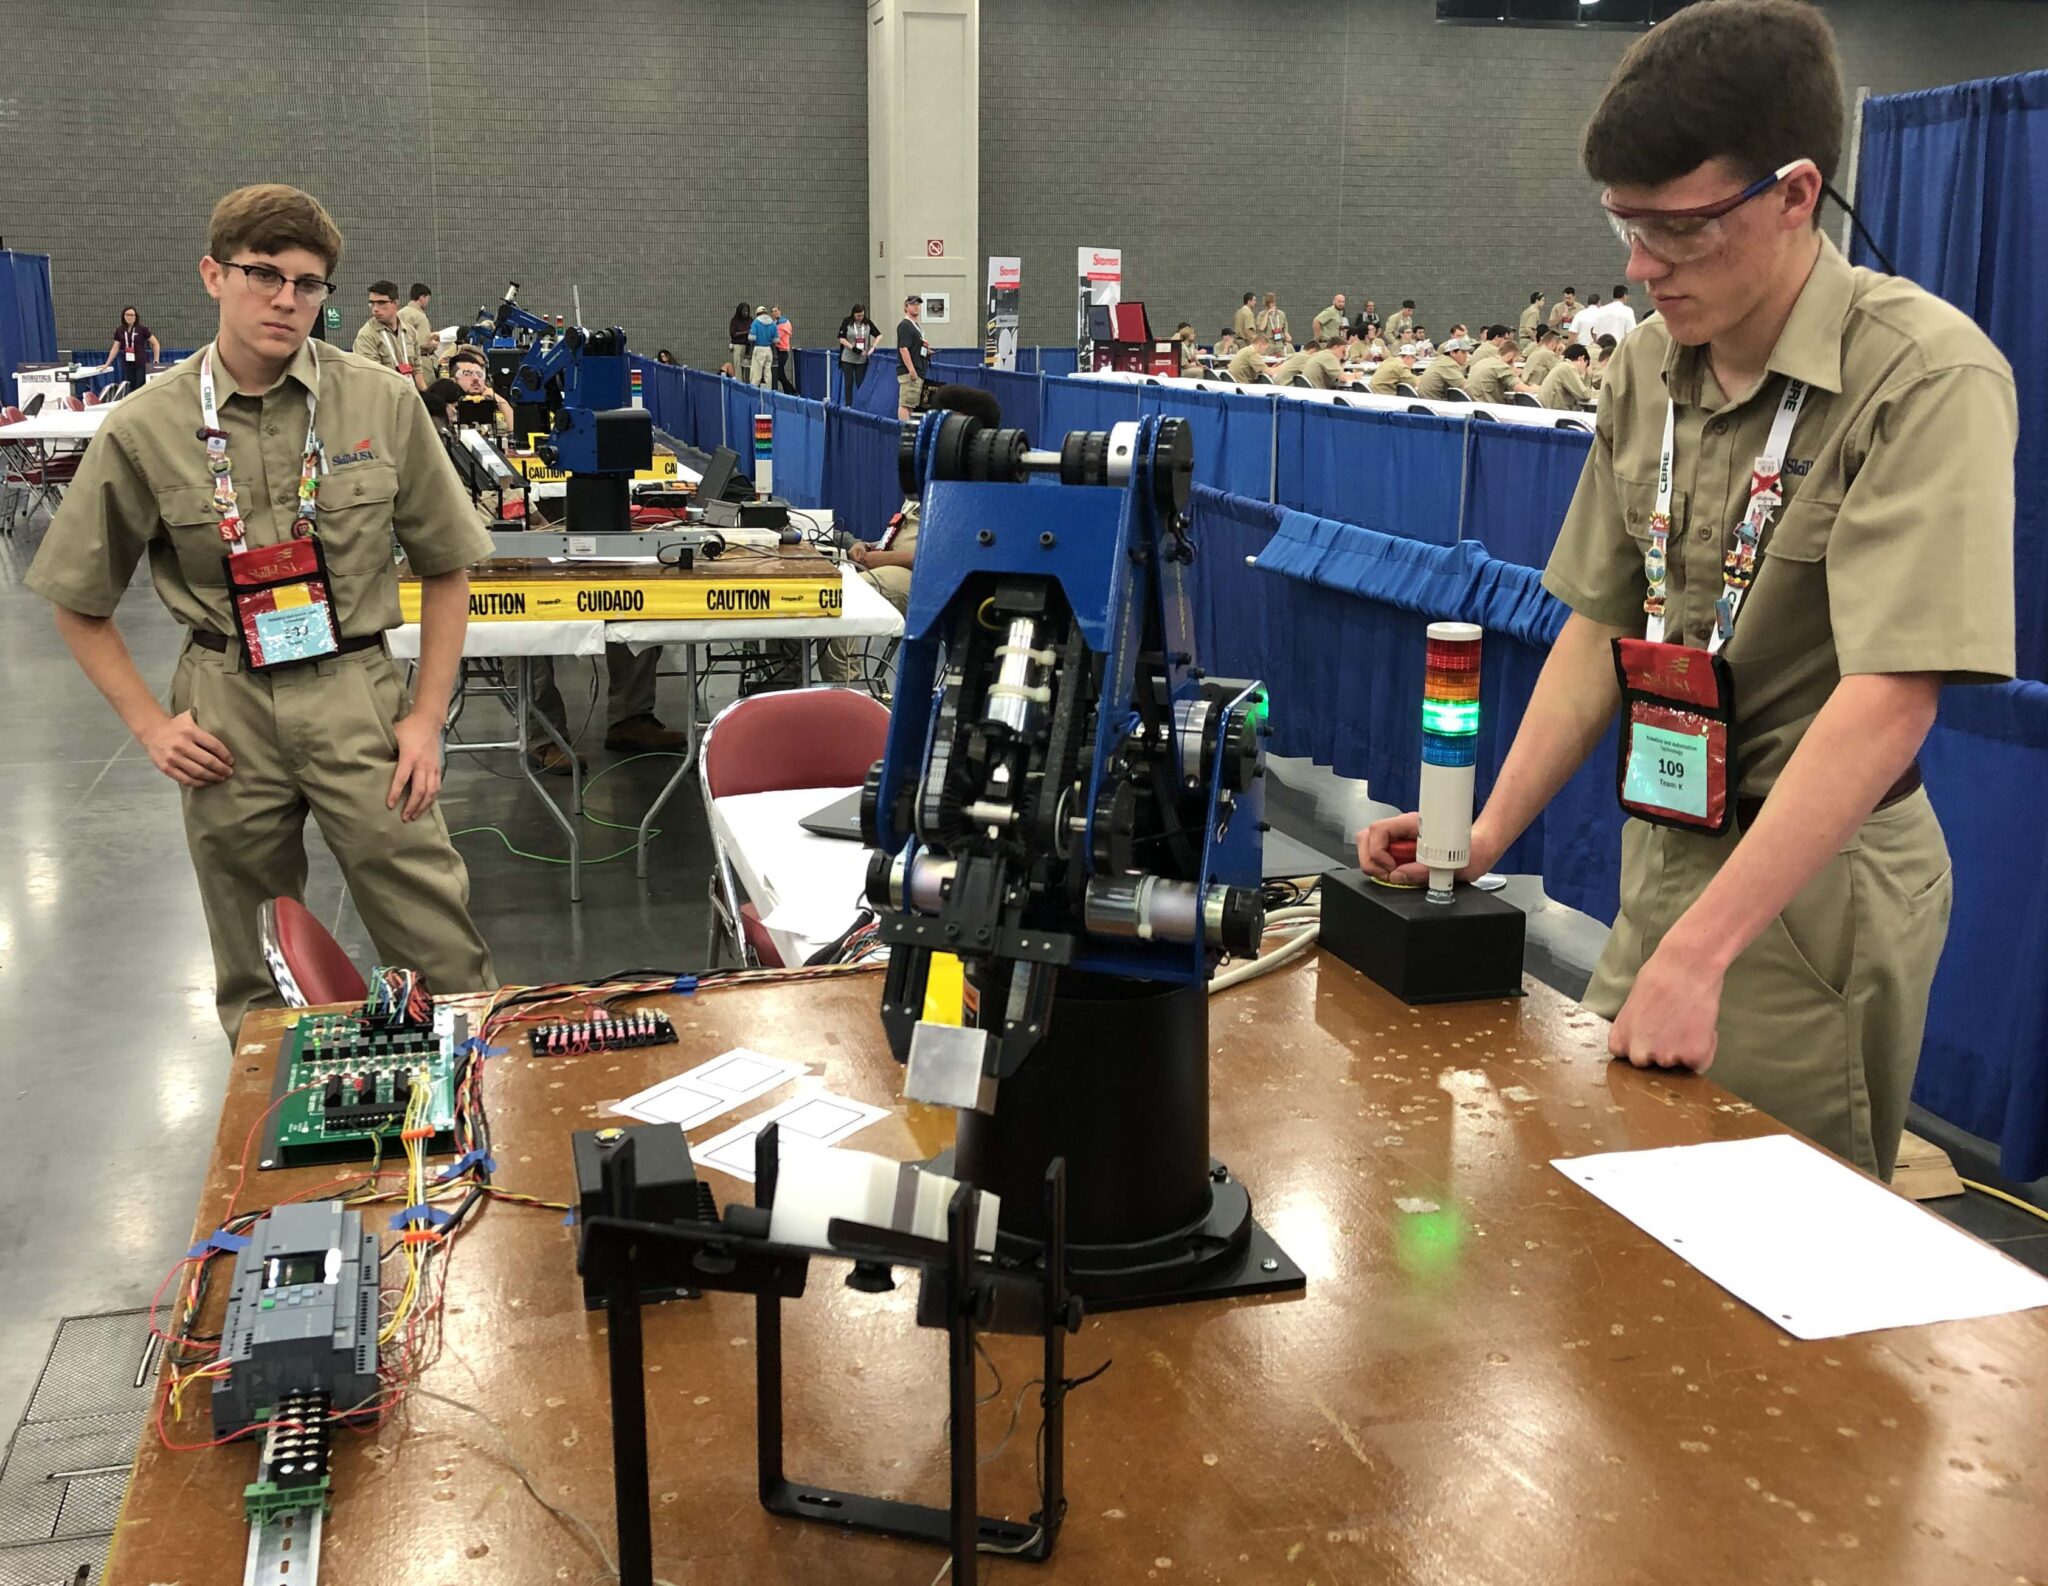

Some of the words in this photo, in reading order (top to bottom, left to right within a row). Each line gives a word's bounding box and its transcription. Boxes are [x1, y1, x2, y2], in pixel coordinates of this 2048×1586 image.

[1783, 380, 1804, 412] BRE
[1660, 451, 1670, 493] CBRE
[468, 592, 526, 616] AUTION
[577, 590, 644, 612] CUIDADO
[707, 588, 770, 611] CAUTION
[1658, 758, 1685, 779] 109
